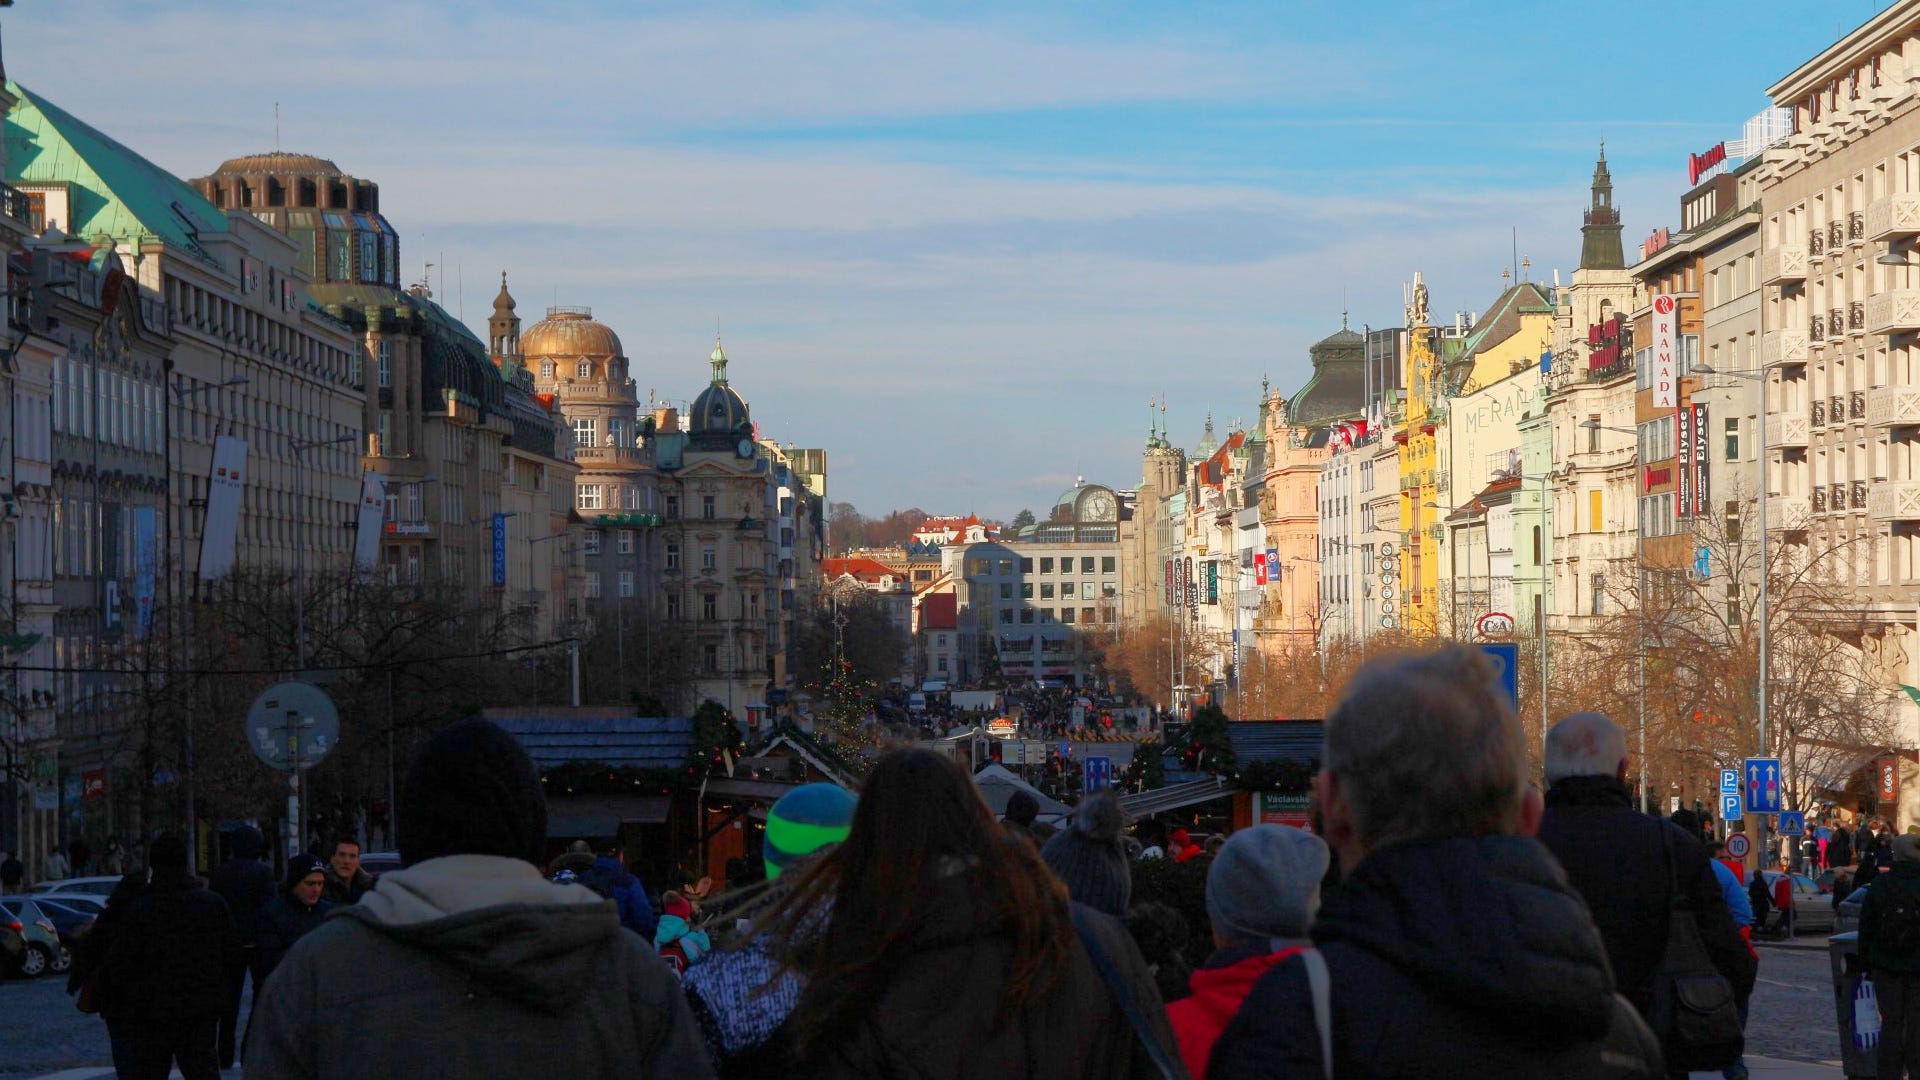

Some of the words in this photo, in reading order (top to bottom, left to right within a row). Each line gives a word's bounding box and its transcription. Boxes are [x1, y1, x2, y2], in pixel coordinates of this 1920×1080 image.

[1658, 323, 1671, 407] RAMADA
[1465, 390, 1527, 433] MERAN
[1679, 411, 1690, 464] Elysee
[1696, 408, 1706, 461] Elysee
[1175, 561, 1183, 604] CASINO
[1208, 566, 1217, 598] GATE
[1484, 620, 1509, 633] C&A
[1724, 772, 1735, 787] P
[1726, 797, 1737, 813] P
[1732, 840, 1744, 852] 10
